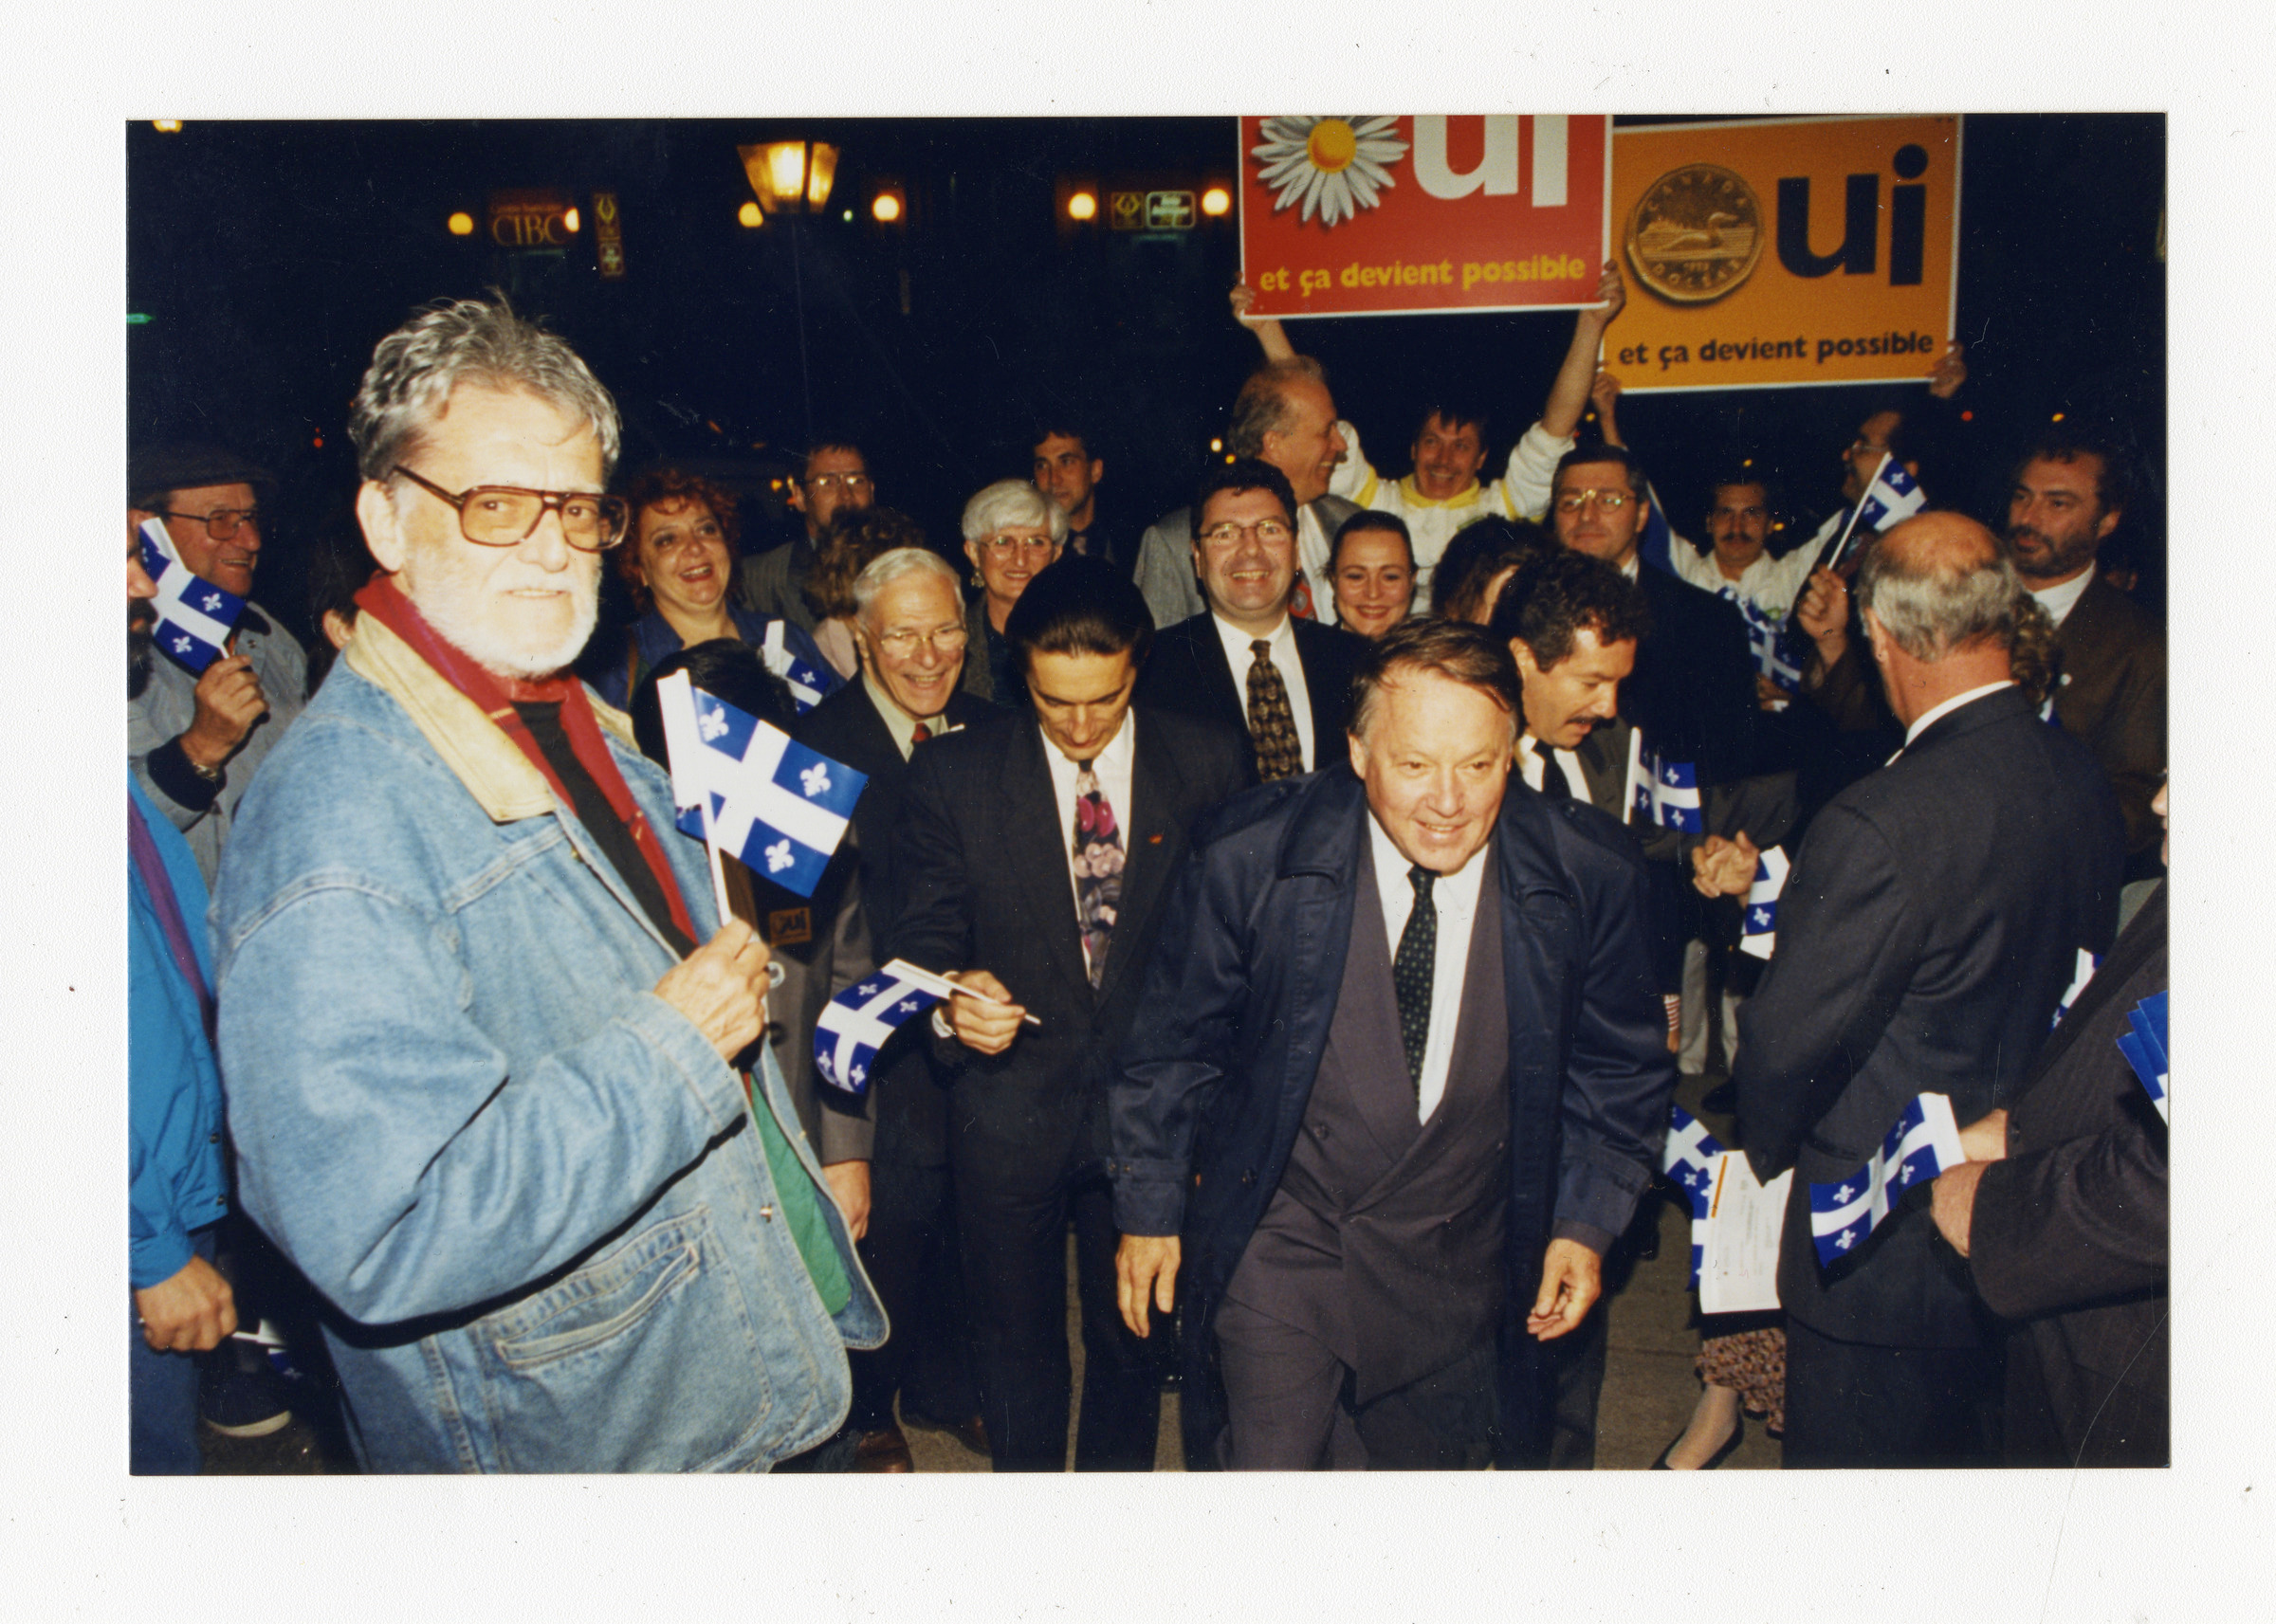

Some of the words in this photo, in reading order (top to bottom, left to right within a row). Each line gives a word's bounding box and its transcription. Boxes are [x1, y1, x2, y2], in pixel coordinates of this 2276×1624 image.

[492, 213, 571, 246] CIBC
[1260, 267, 1290, 291] et
[1299, 267, 1331, 297] ça
[1340, 259, 1453, 287] devient
[1462, 253, 1586, 291] possible
[1619, 342, 1648, 365] et
[1659, 344, 1690, 370] ça
[1699, 336, 1808, 362] devient
[1816, 331, 1935, 364] possible
